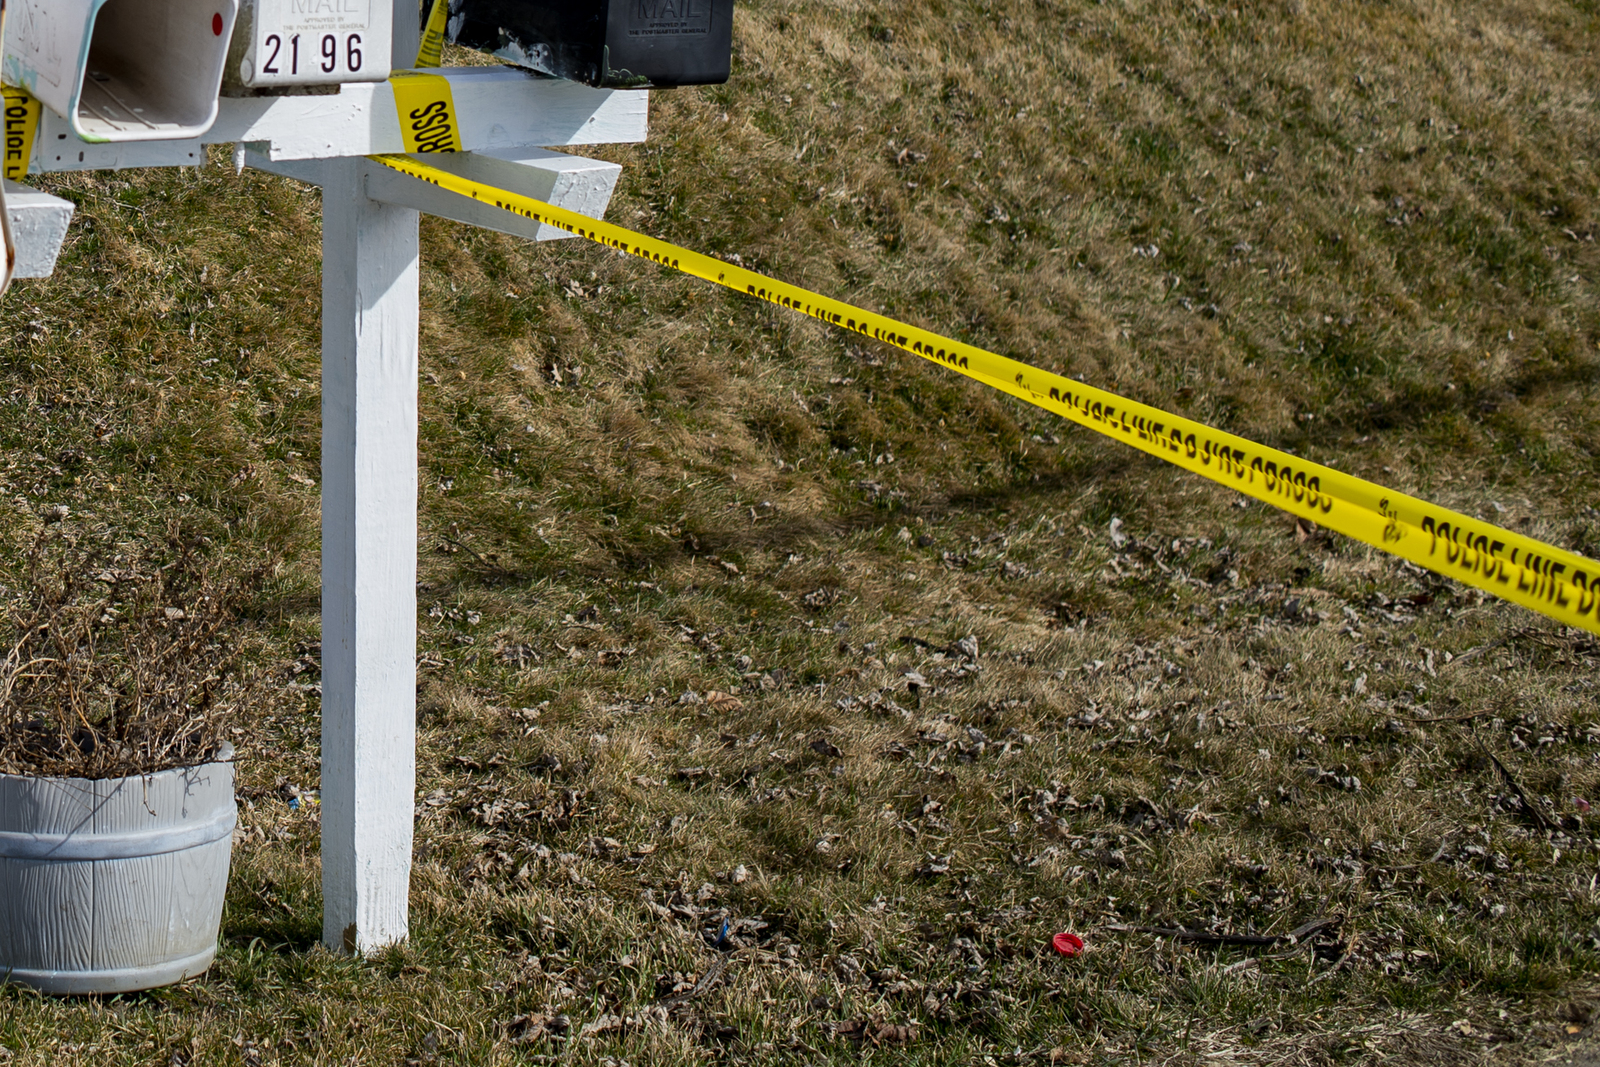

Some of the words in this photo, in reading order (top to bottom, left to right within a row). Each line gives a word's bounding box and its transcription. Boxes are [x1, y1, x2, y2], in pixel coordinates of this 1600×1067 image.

[263, 33, 362, 75] 2196
[409, 100, 455, 153] ROSS
[1421, 516, 1510, 585] POLICE
